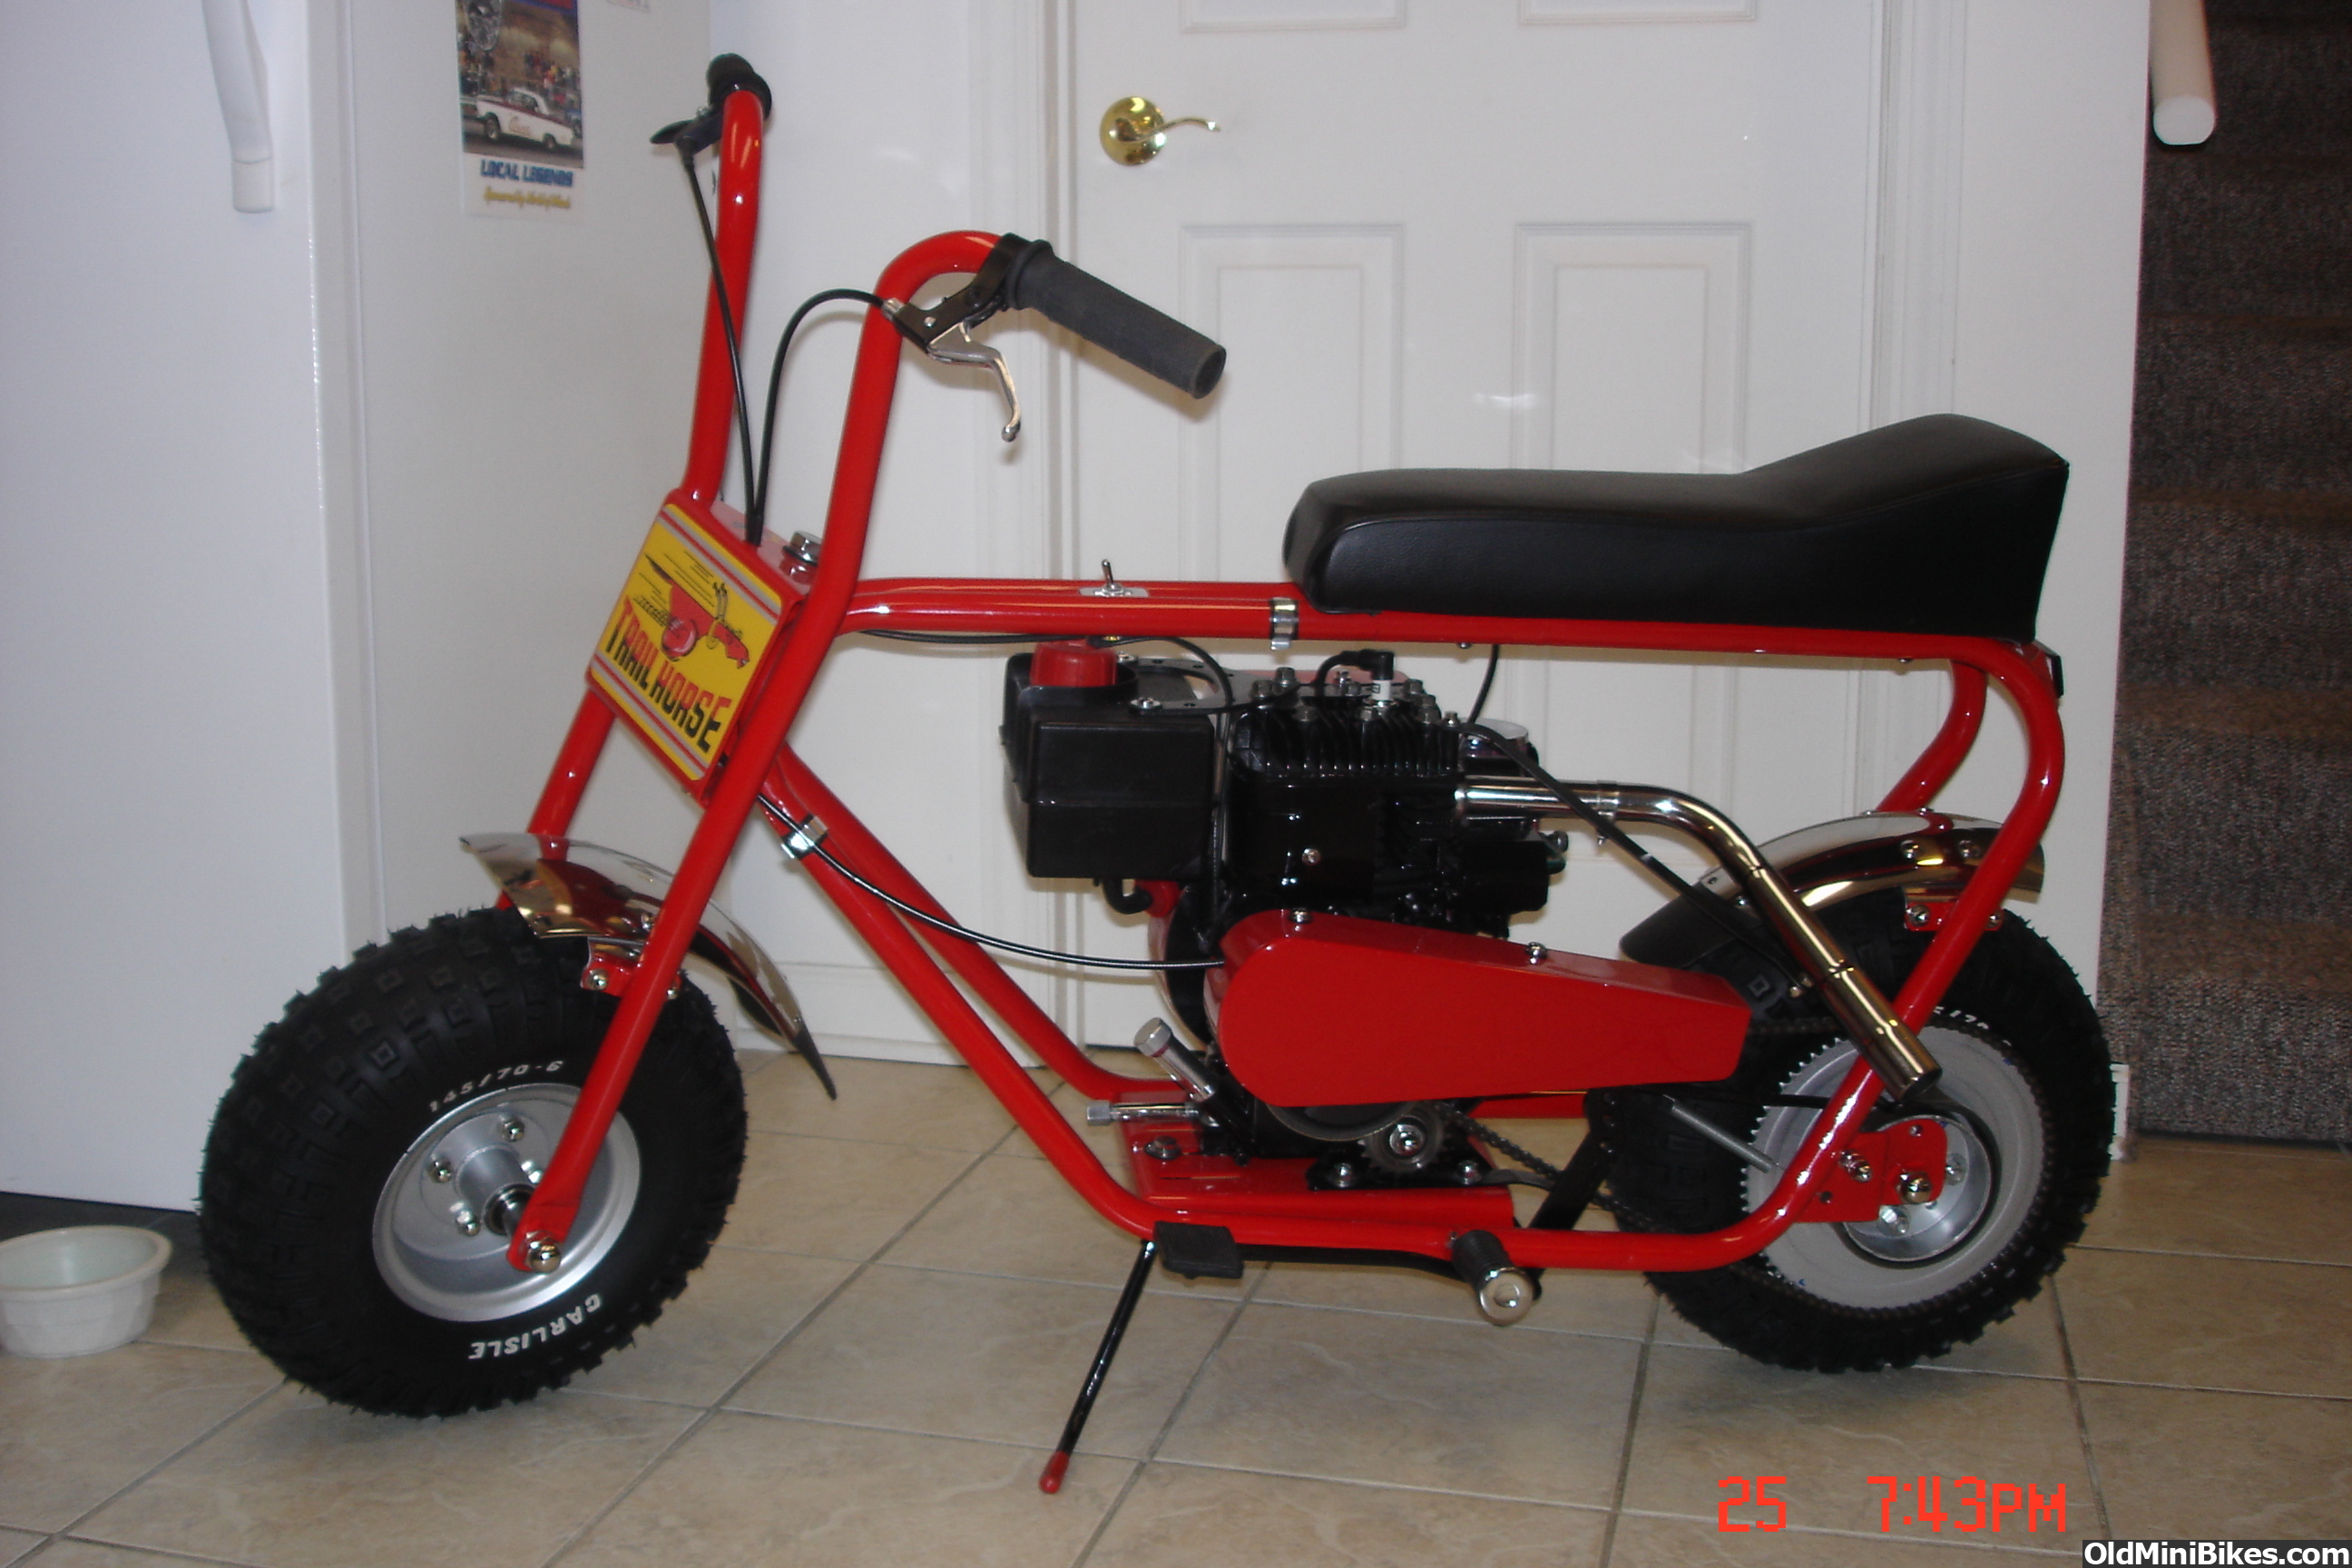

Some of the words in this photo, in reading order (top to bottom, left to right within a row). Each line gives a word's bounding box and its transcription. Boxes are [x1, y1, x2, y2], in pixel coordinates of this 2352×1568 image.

[480, 159, 520, 181] LOCAL
[604, 595, 660, 690] TRAIL
[649, 660, 732, 753] HORSE
[429, 1061, 564, 1112] 145/70-6
[468, 1293, 603, 1359] CARLISLE
